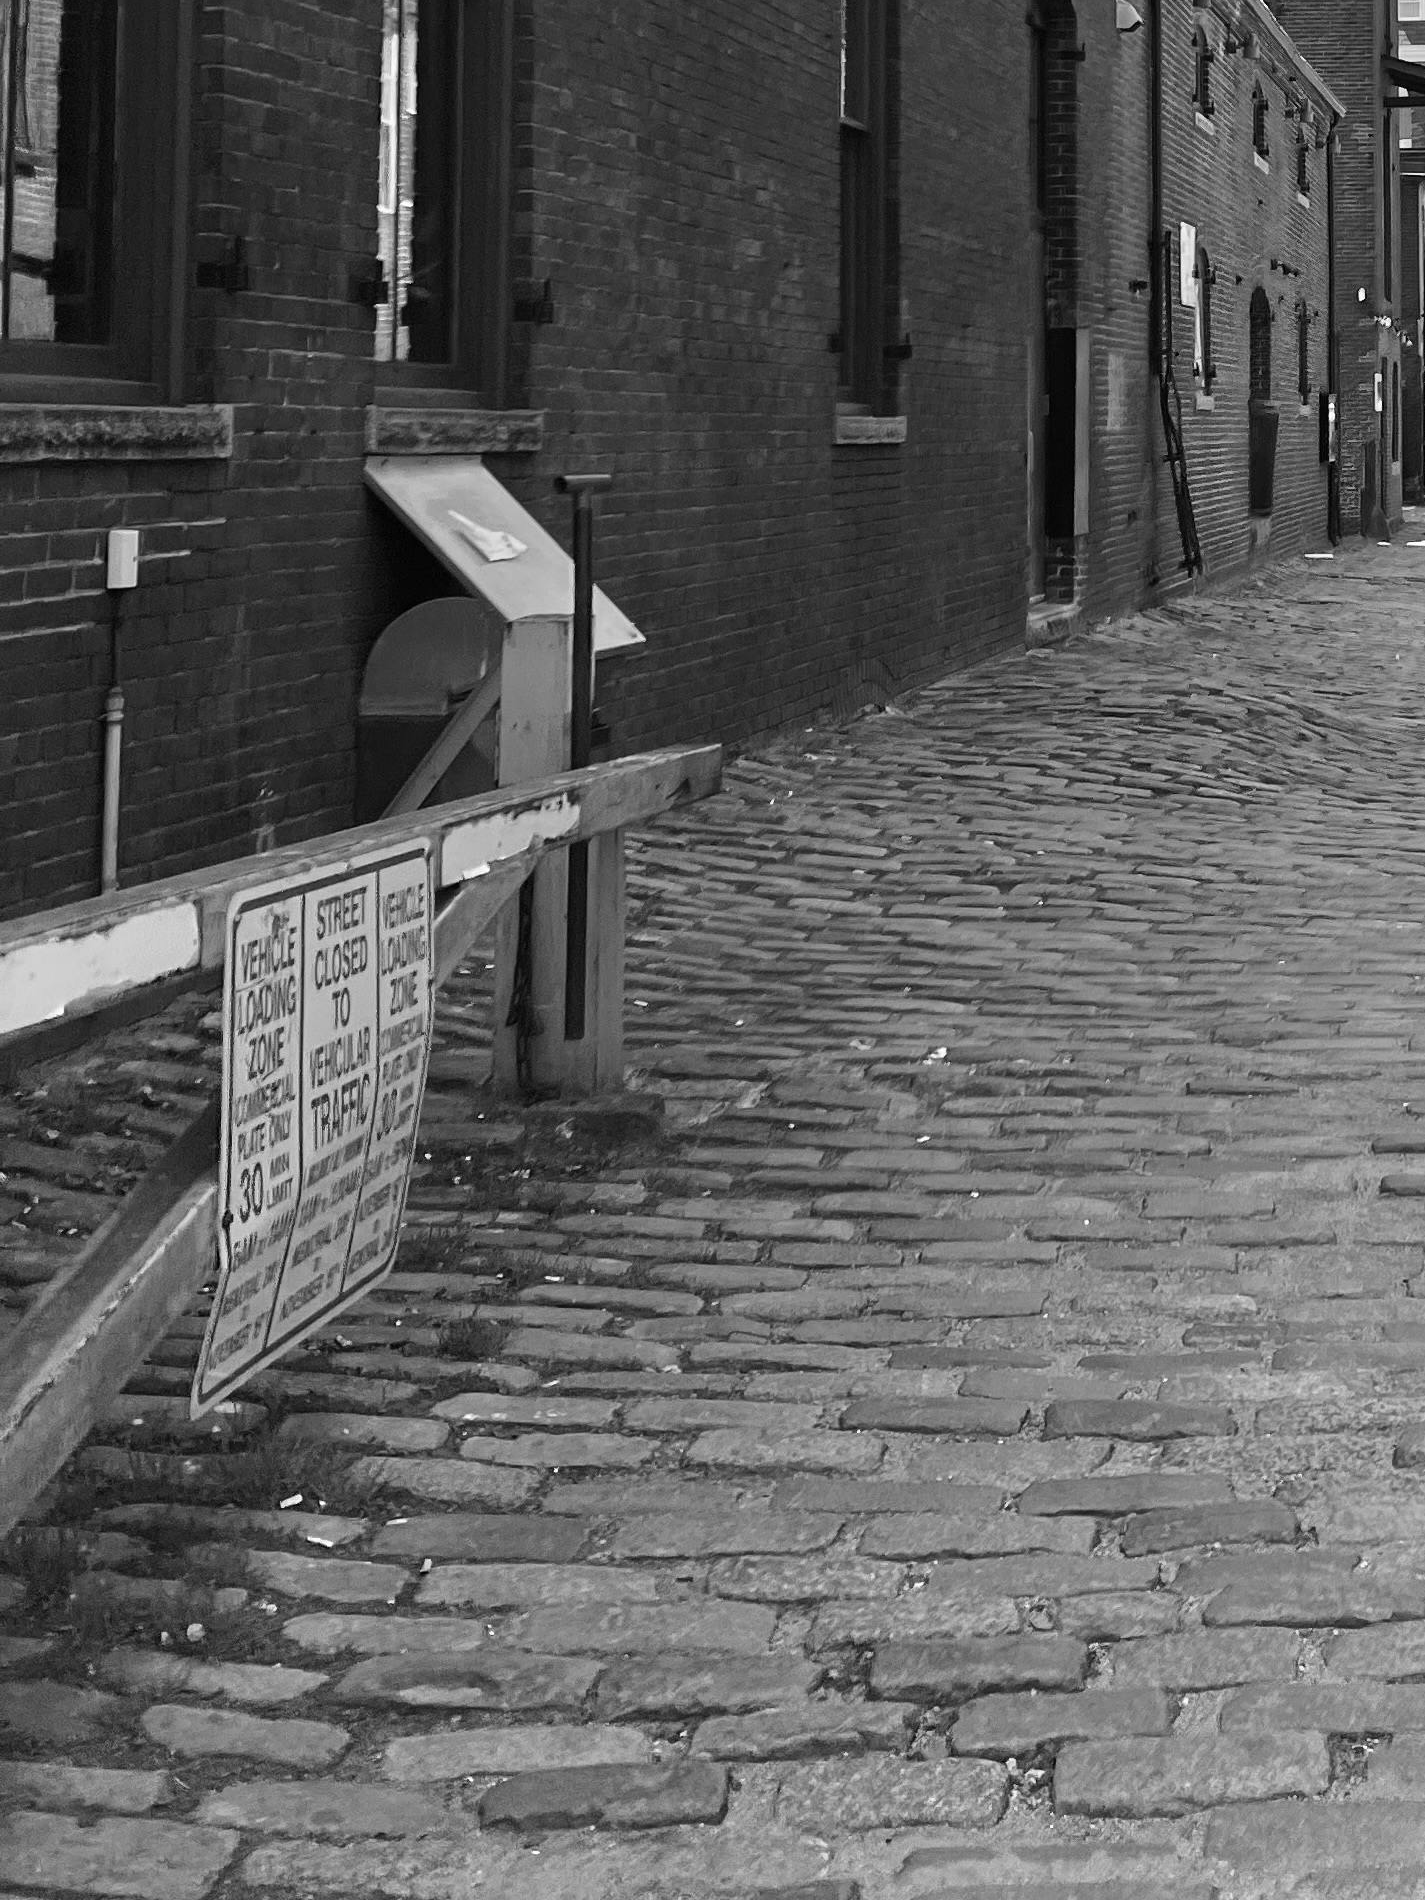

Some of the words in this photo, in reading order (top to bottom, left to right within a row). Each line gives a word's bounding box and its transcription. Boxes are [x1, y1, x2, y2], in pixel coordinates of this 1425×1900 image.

[316, 886, 368, 941] STREET
[241, 927, 297, 983] VEHICLE
[314, 935, 368, 990] CLOSED
[237, 975, 296, 1036] LOADING
[332, 987, 351, 1030] TO
[248, 1026, 285, 1080] ZONE
[308, 1026, 370, 1090] VEHICULAR
[311, 1073, 370, 1151] TRAFFIC
[239, 1162, 263, 1223] 30
